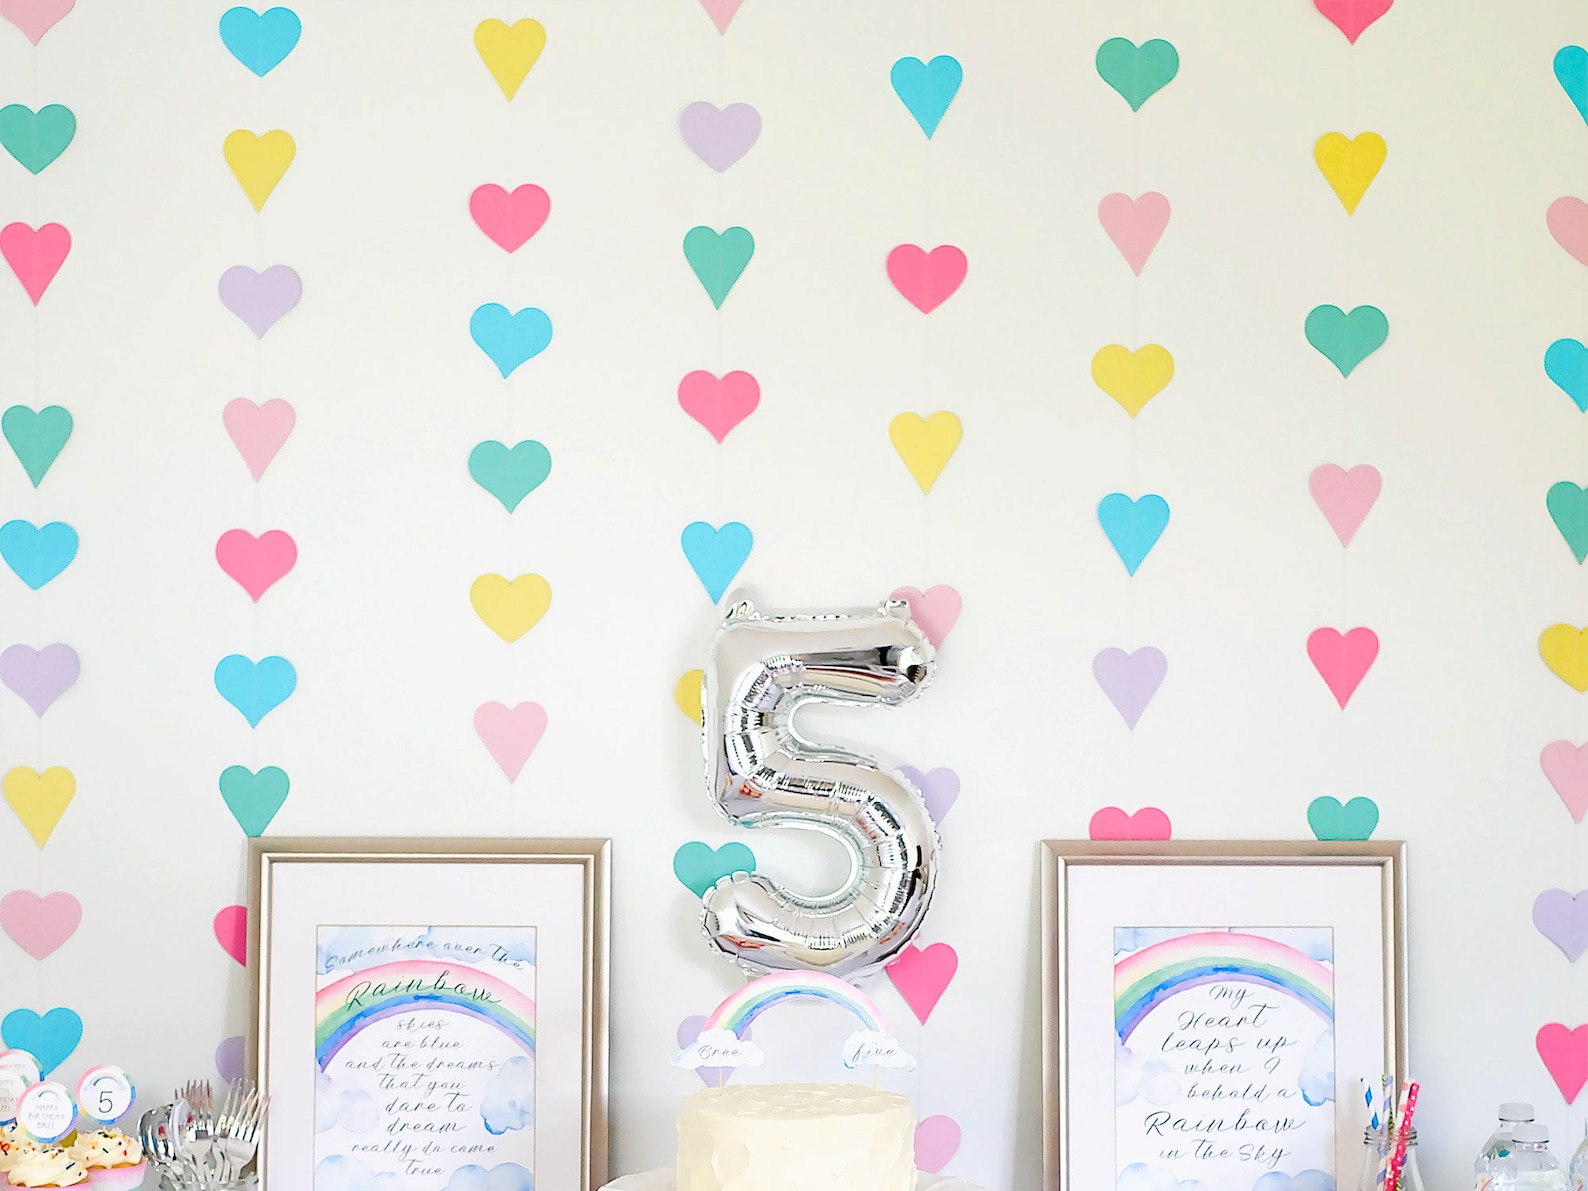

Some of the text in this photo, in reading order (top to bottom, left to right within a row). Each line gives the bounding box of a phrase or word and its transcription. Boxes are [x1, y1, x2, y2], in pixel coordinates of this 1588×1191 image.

[700, 596, 940, 980] 5
[325, 938, 523, 971] Somewhere over the
[346, 970, 502, 1011] Rainbow
[1208, 984, 1254, 1009] My
[396, 1017, 449, 1033] skies
[1178, 1002, 1280, 1030] Heart
[381, 1035, 464, 1050] are blue
[1161, 1031, 1299, 1055] leaps up
[345, 1052, 502, 1072] and the dreams
[1184, 1056, 1282, 1075] when I
[376, 1073, 467, 1098] that you
[1187, 1082, 1298, 1102] behold a
[98, 1090, 114, 1114] 5
[385, 1092, 474, 1116] dare to
[386, 1116, 467, 1136] dream
[1144, 1107, 1307, 1136] Rainbow
[351, 1139, 500, 1161] really do come
[1159, 1138, 1292, 1169] in the Sky
[405, 1158, 446, 1176] true
